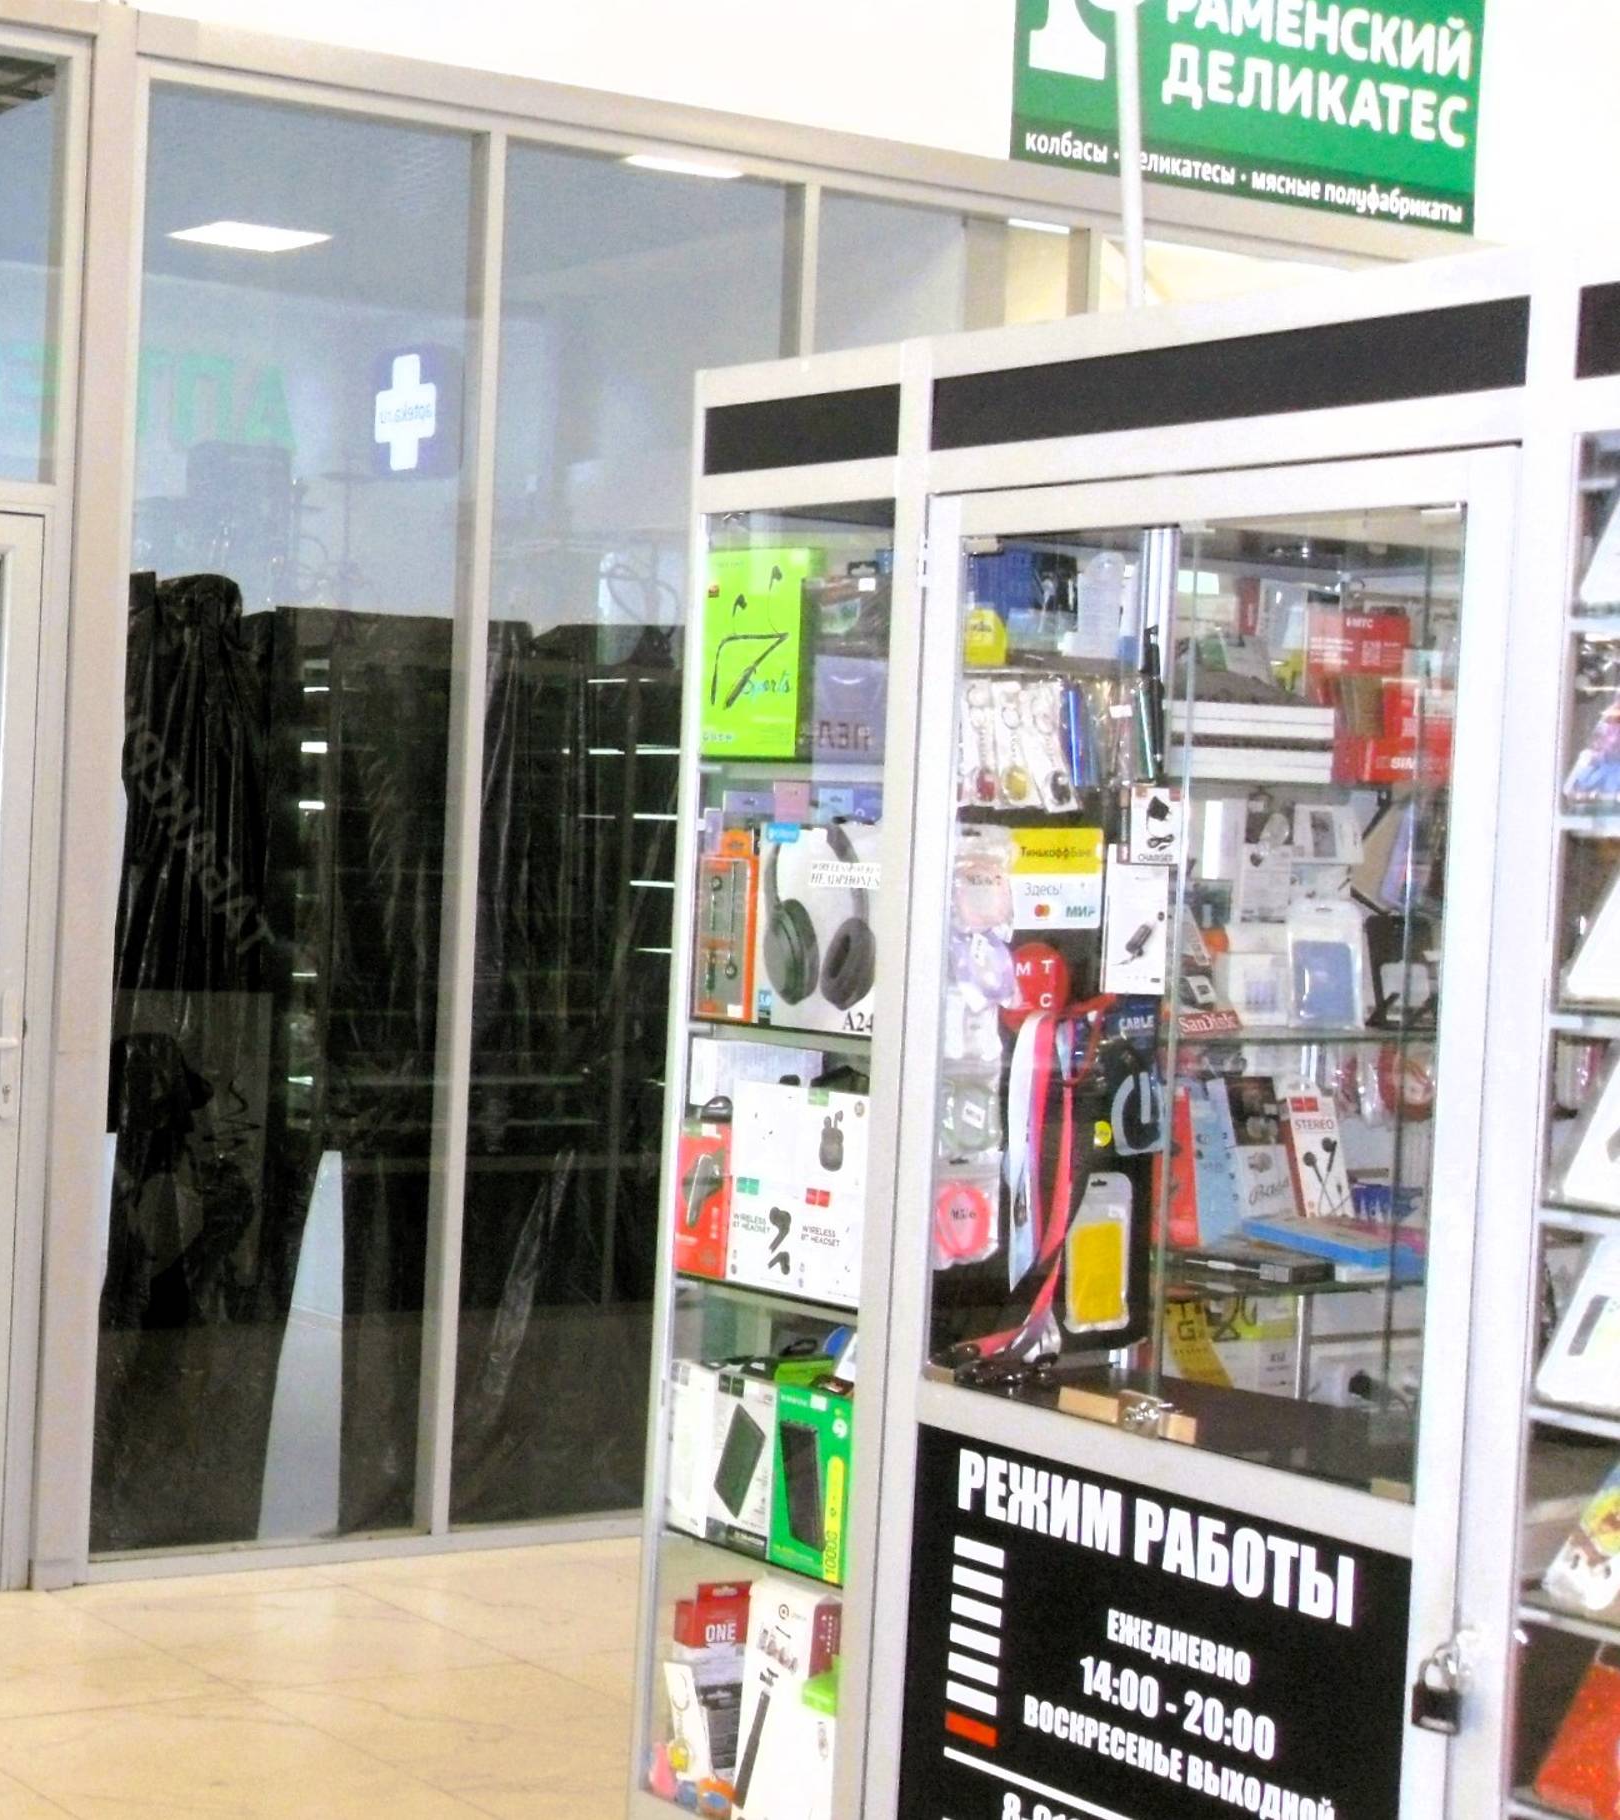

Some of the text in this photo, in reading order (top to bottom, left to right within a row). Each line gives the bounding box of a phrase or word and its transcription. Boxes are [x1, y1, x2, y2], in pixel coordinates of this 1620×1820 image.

[1161, 42, 1469, 149] ДЕЛИКАТЕС
[1025, 130, 1463, 225] колбасы еликатесы мясные полуфабрикаты
[1118, 1016, 1154, 1031] CABLE
[1178, 1012, 1238, 1035] SanDisk
[1294, 1118, 1335, 1130] STEREO
[802, 1225, 836, 1238] WIRELESS
[810, 1235, 841, 1247] HEADSET
[957, 1448, 1357, 1628] РЕЖИМ РАБОТЫ
[705, 1622, 737, 1643] ONE
[1106, 1608, 1252, 1687] ЕЖЕДНЕВНО
[1080, 1655, 1160, 1719] 14:00
[1182, 1689, 1276, 1761] 20:00
[1023, 1694, 1336, 1820] ВОСКРЕСЕНЬЕ ВЫХОДНОЙ
